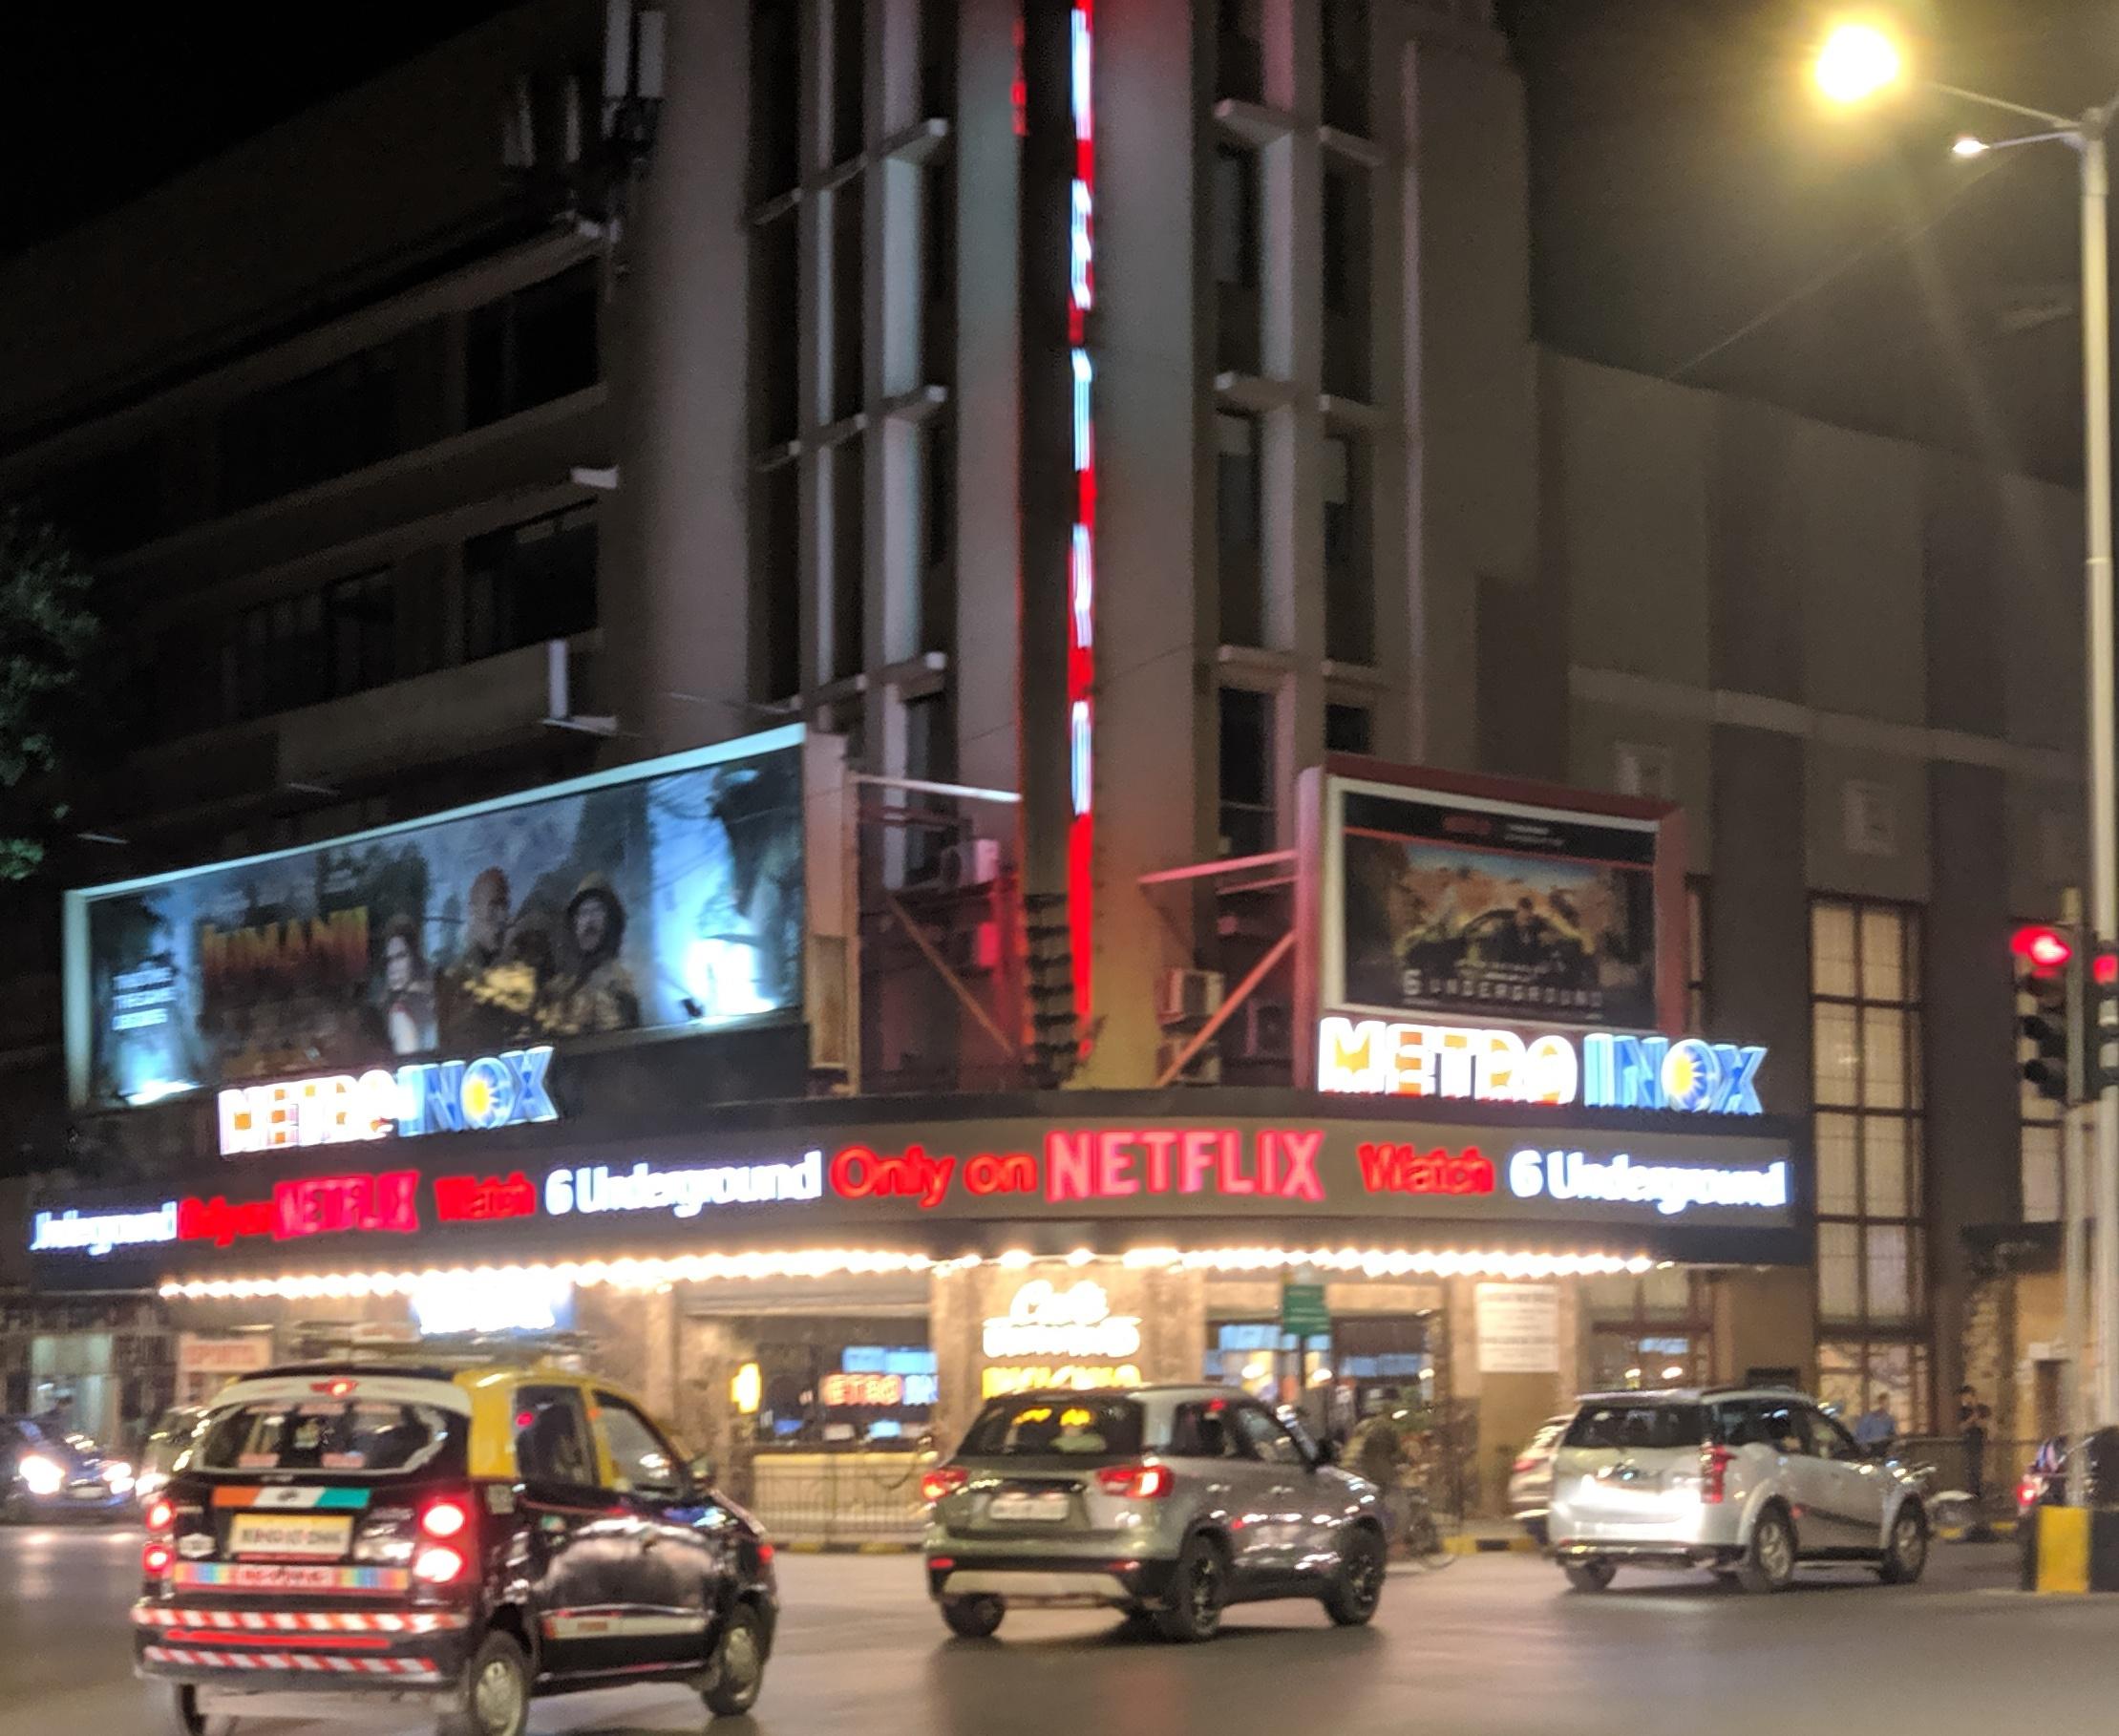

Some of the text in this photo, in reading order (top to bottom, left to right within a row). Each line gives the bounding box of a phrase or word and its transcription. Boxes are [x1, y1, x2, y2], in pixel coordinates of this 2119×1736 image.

[1318, 1016, 1768, 1115] METRO INOX
[273, 1169, 421, 1241] NETFLIX
[545, 1169, 573, 1216] 6
[830, 1146, 955, 1207] Only
[964, 1153, 1038, 1196] on
[1046, 1131, 1325, 1203] NETFLIX
[1357, 1143, 1495, 1196] Watch
[1509, 1149, 1544, 1198] 6
